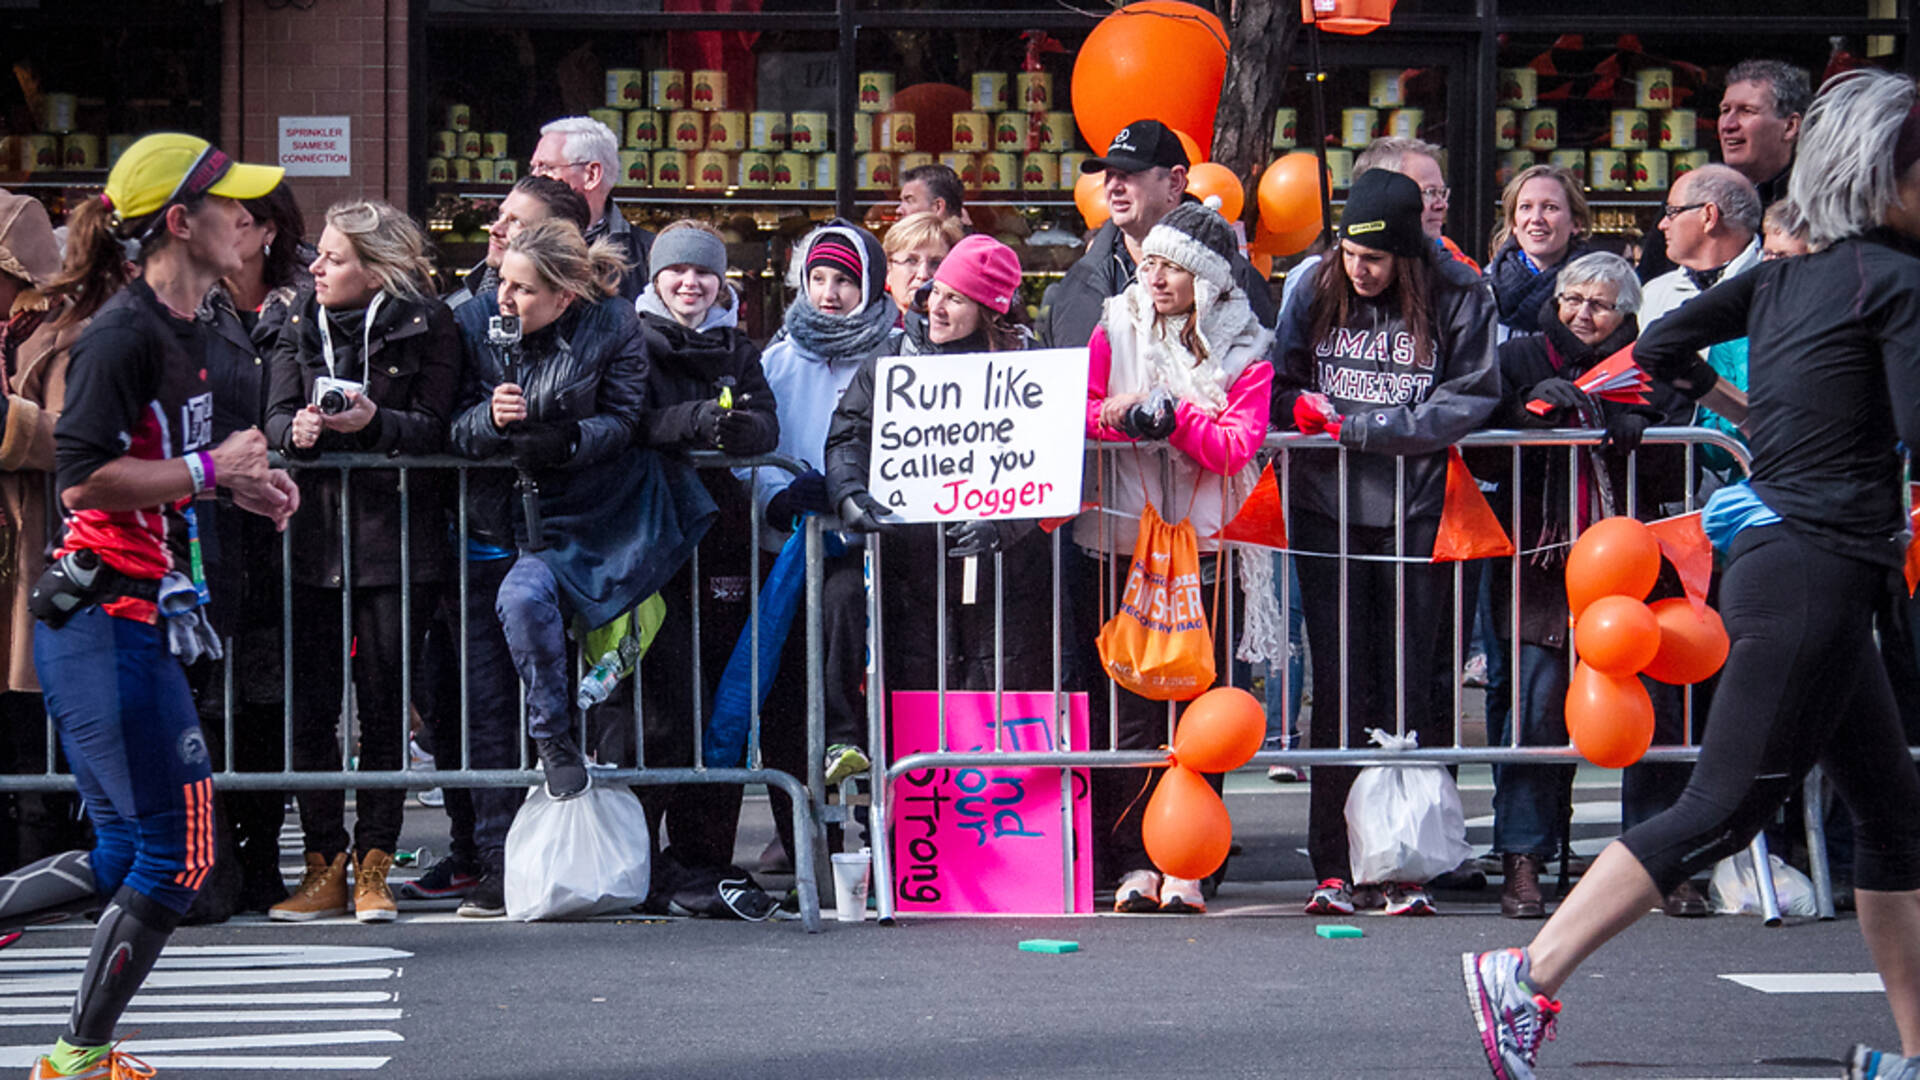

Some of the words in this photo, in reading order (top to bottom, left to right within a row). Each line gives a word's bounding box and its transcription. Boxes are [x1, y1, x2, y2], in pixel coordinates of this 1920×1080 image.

[285, 127, 343, 137] SPRINKLER
[292, 141, 337, 151] SIAMESE
[281, 153, 348, 164] CONNECTION
[886, 364, 962, 413] Run
[990, 449, 1036, 486] you
[888, 489, 907, 507] a
[933, 479, 1053, 517] Jogger
[986, 716, 1054, 839] Fnd
